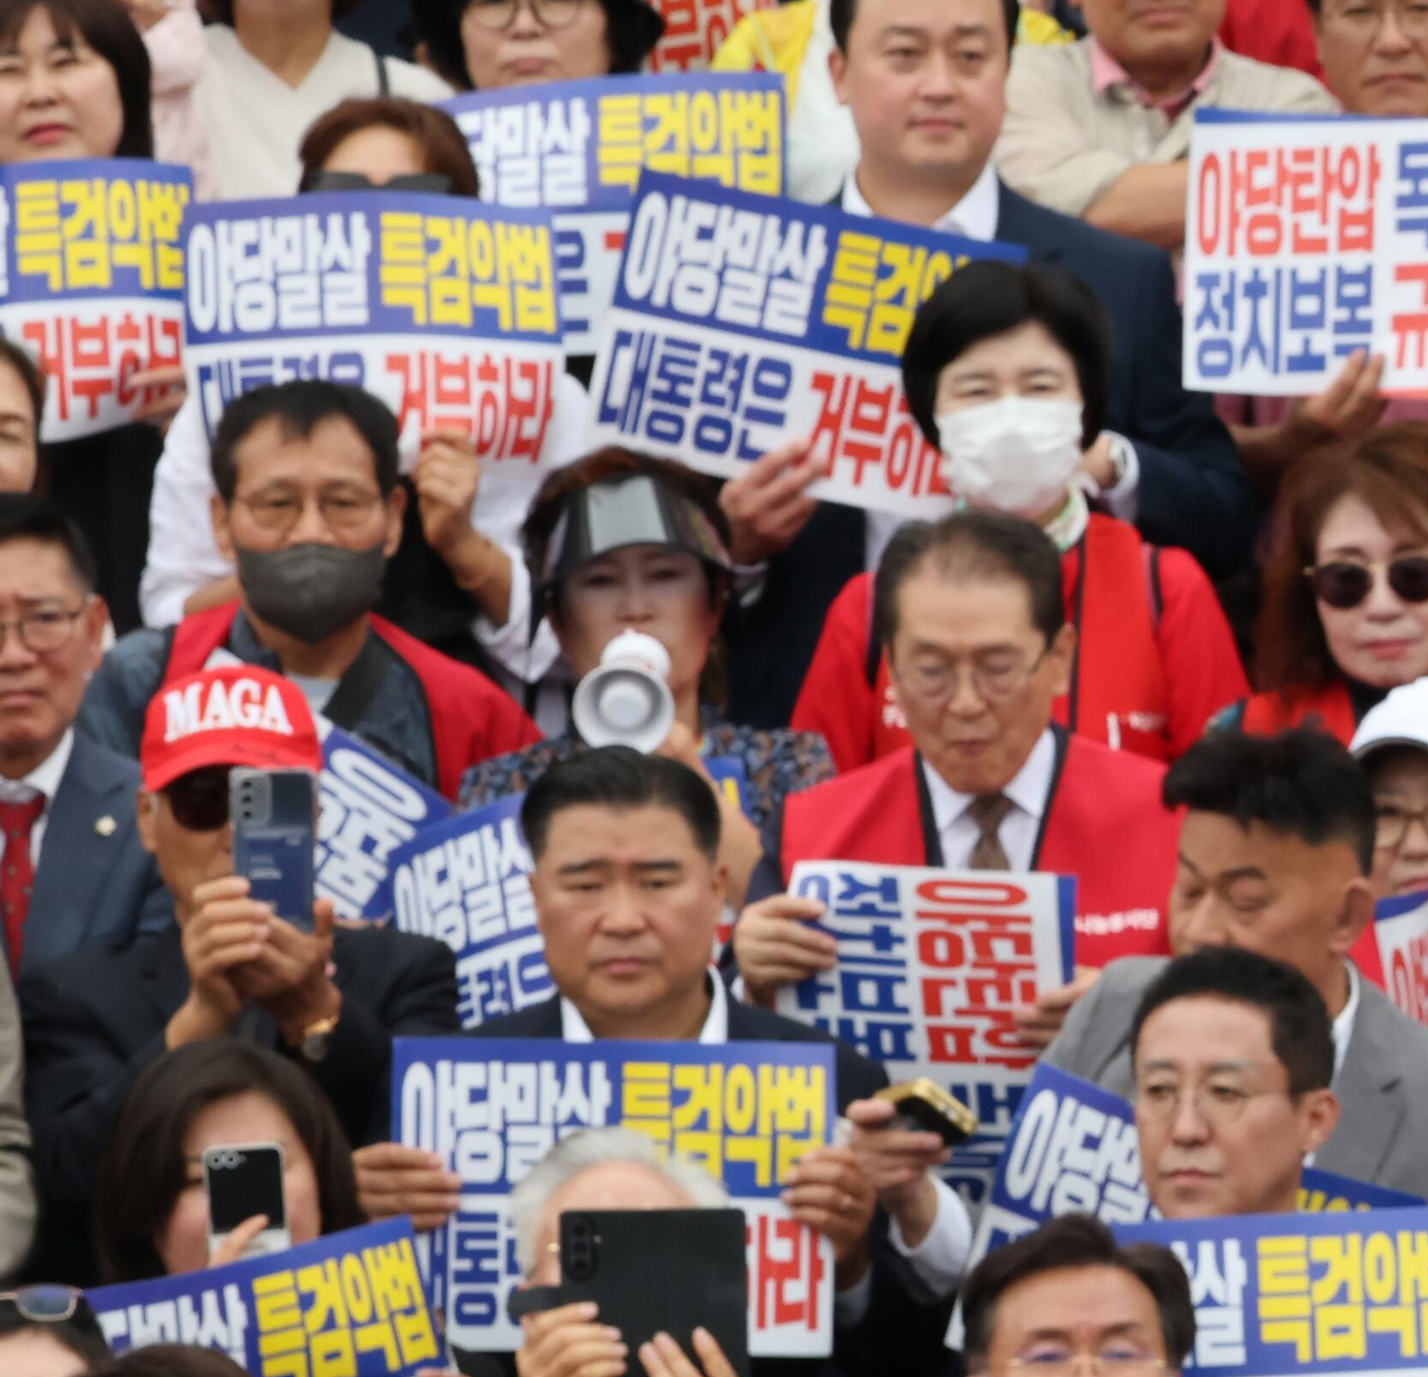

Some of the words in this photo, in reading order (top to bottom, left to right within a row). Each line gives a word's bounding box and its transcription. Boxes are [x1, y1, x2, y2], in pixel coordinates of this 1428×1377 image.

[1199, 143, 1380, 257] 야당탄압
[188, 213, 371, 333] 야당말살
[380, 211, 557, 334] 특검악법
[624, 190, 828, 336] 야당말살
[1194, 266, 1374, 378] 정치보복
[386, 353, 555, 464] 거부하라
[597, 328, 793, 462] 대통령은
[808, 368, 955, 498] 거부하
[164, 679, 295, 742] MAGA
[1170, 1237, 1247, 1368] 살
